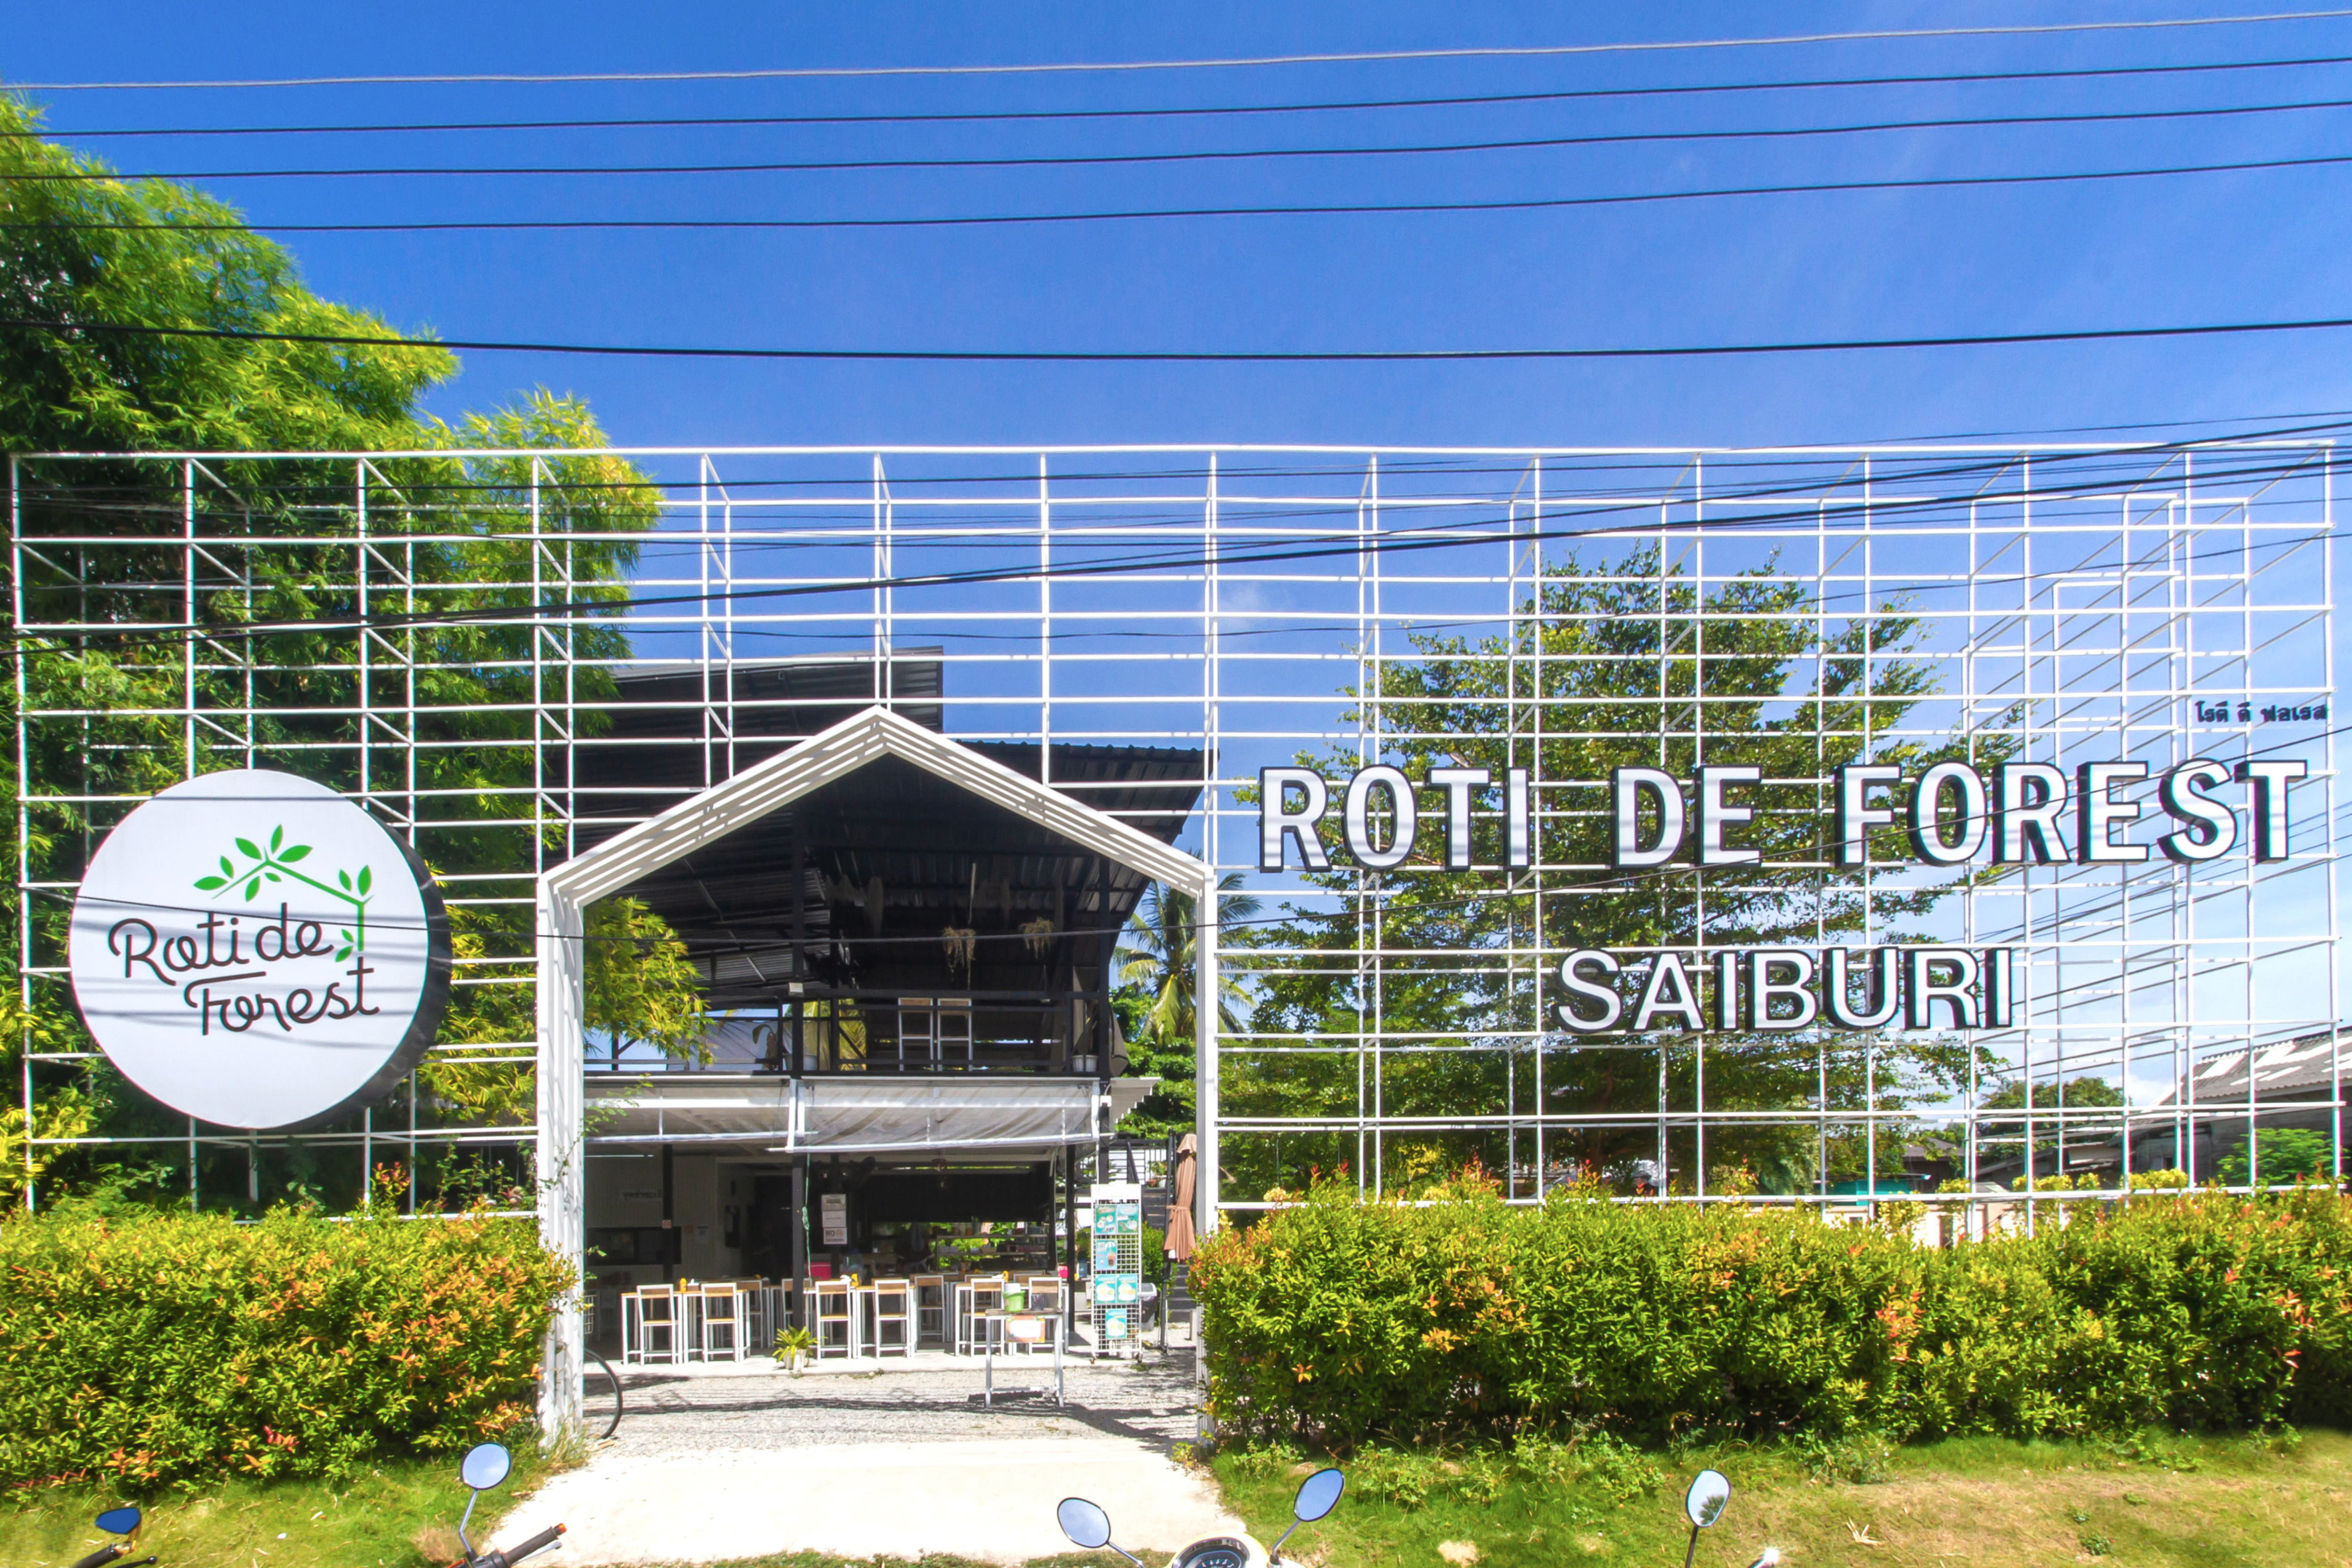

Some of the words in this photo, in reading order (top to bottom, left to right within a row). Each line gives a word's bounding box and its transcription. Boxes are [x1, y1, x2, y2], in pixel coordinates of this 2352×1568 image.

[1260, 763, 1530, 873] ROTI
[1610, 765, 1762, 870] DE
[1834, 758, 2307, 870] FOREST
[108, 911, 250, 986] Roti
[255, 902, 334, 961] de
[184, 956, 380, 1036] Forest
[1551, 948, 2013, 1033] SAIBURI
